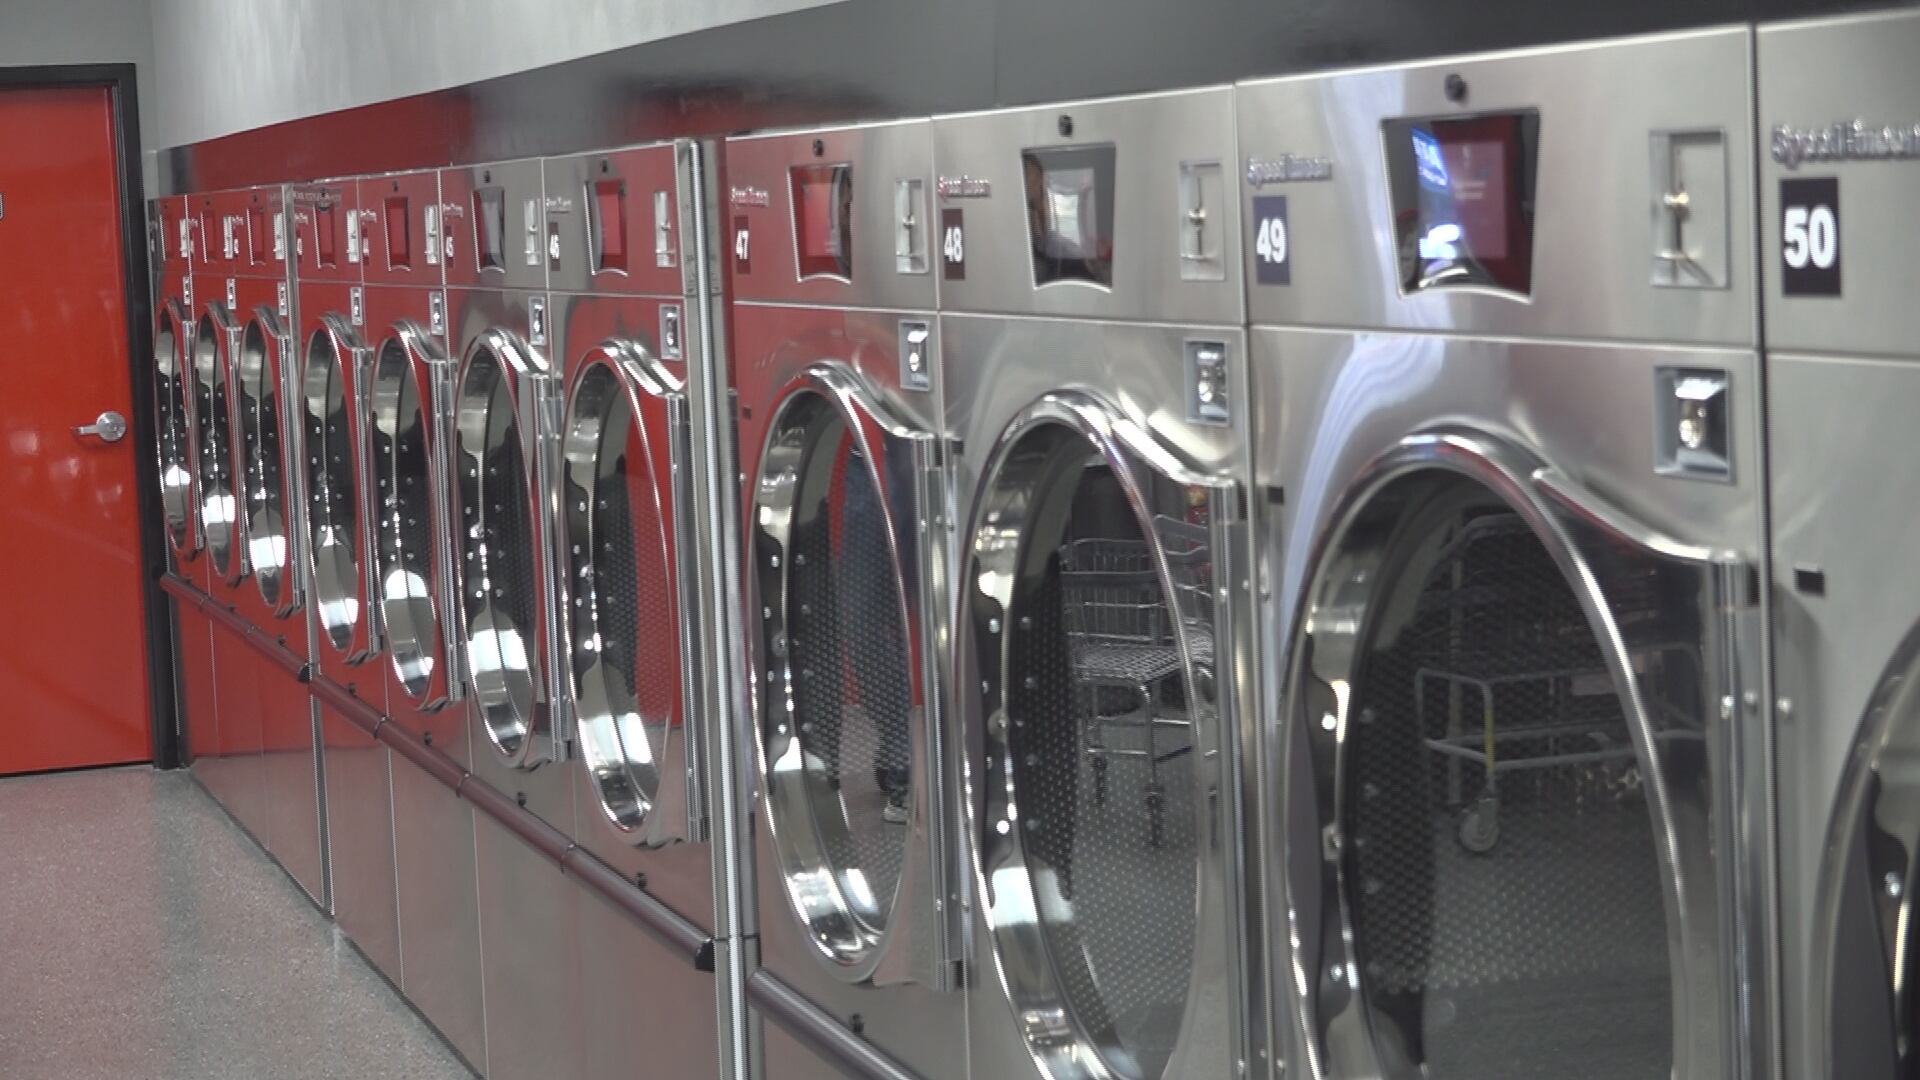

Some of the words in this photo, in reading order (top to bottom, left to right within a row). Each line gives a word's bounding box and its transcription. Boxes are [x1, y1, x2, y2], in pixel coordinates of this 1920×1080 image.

[736, 230, 749, 260] 47
[944, 226, 963, 262] 48
[1256, 217, 1286, 263] 49
[1783, 205, 1838, 269] 50
